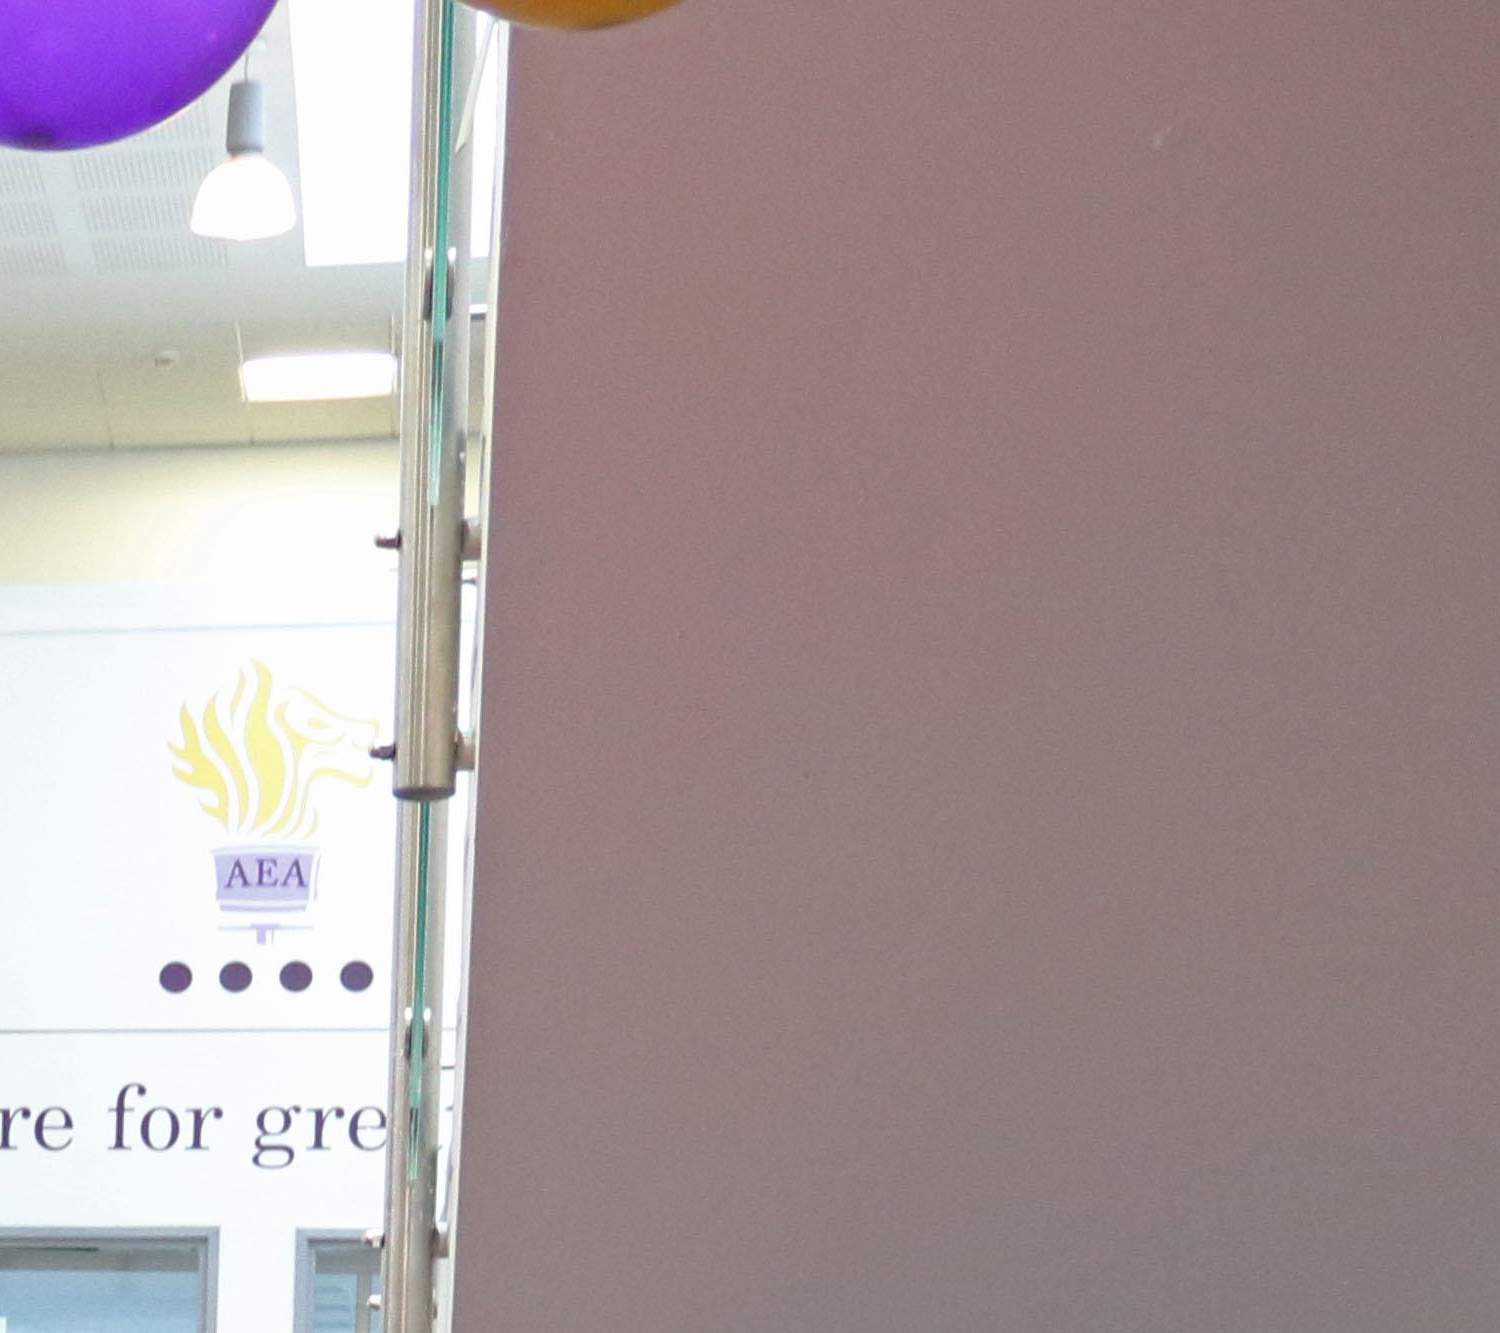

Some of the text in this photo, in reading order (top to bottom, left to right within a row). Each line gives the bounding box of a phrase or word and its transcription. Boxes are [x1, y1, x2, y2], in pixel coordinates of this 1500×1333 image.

[224, 857, 308, 889] AEA
[107, 1082, 224, 1152] for
[251, 1103, 388, 1170] gre
